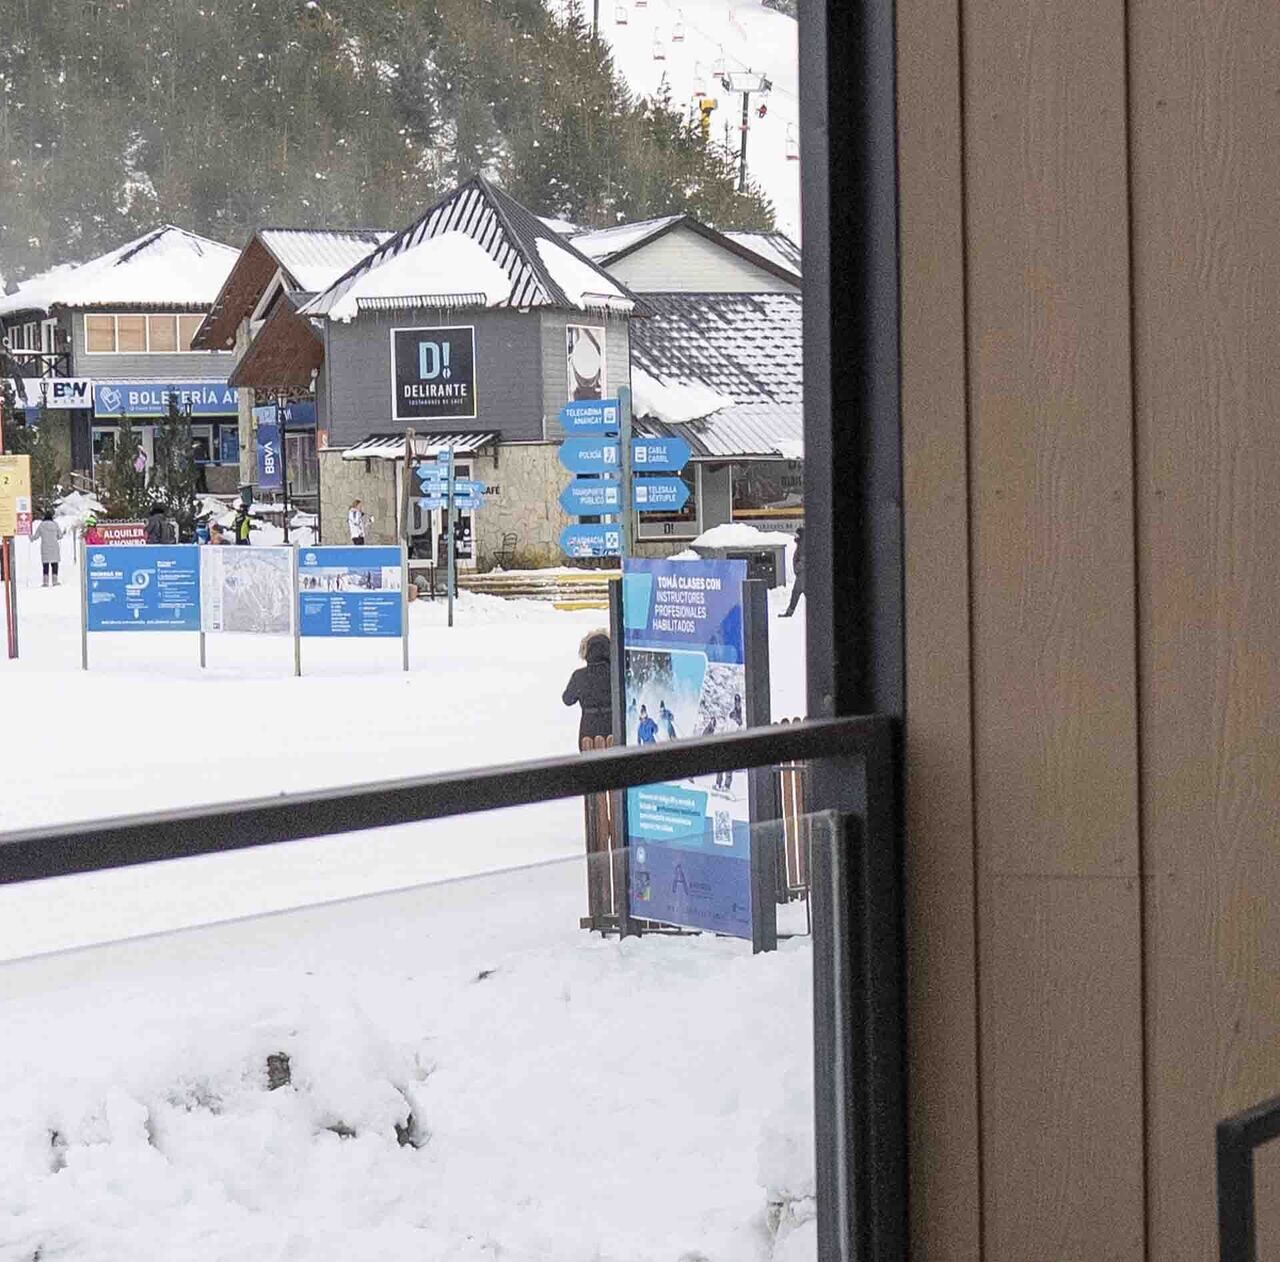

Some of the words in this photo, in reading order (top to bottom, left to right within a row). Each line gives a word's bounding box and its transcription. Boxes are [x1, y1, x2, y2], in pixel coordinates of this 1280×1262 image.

[419, 341, 452, 380] D!
[404, 383, 468, 398] DELIRANTE
[264, 440, 275, 474] BBVA
[104, 528, 144, 539] ALQUILER
[657, 573, 678, 589] TOMÁ
[678, 575, 705, 590] CLASES
[705, 577, 721, 590] CON
[656, 592, 705, 605] INSTRUCTORES
[654, 604, 707, 619] PROFESIONALES
[652, 619, 696, 633] HABILITADOS
